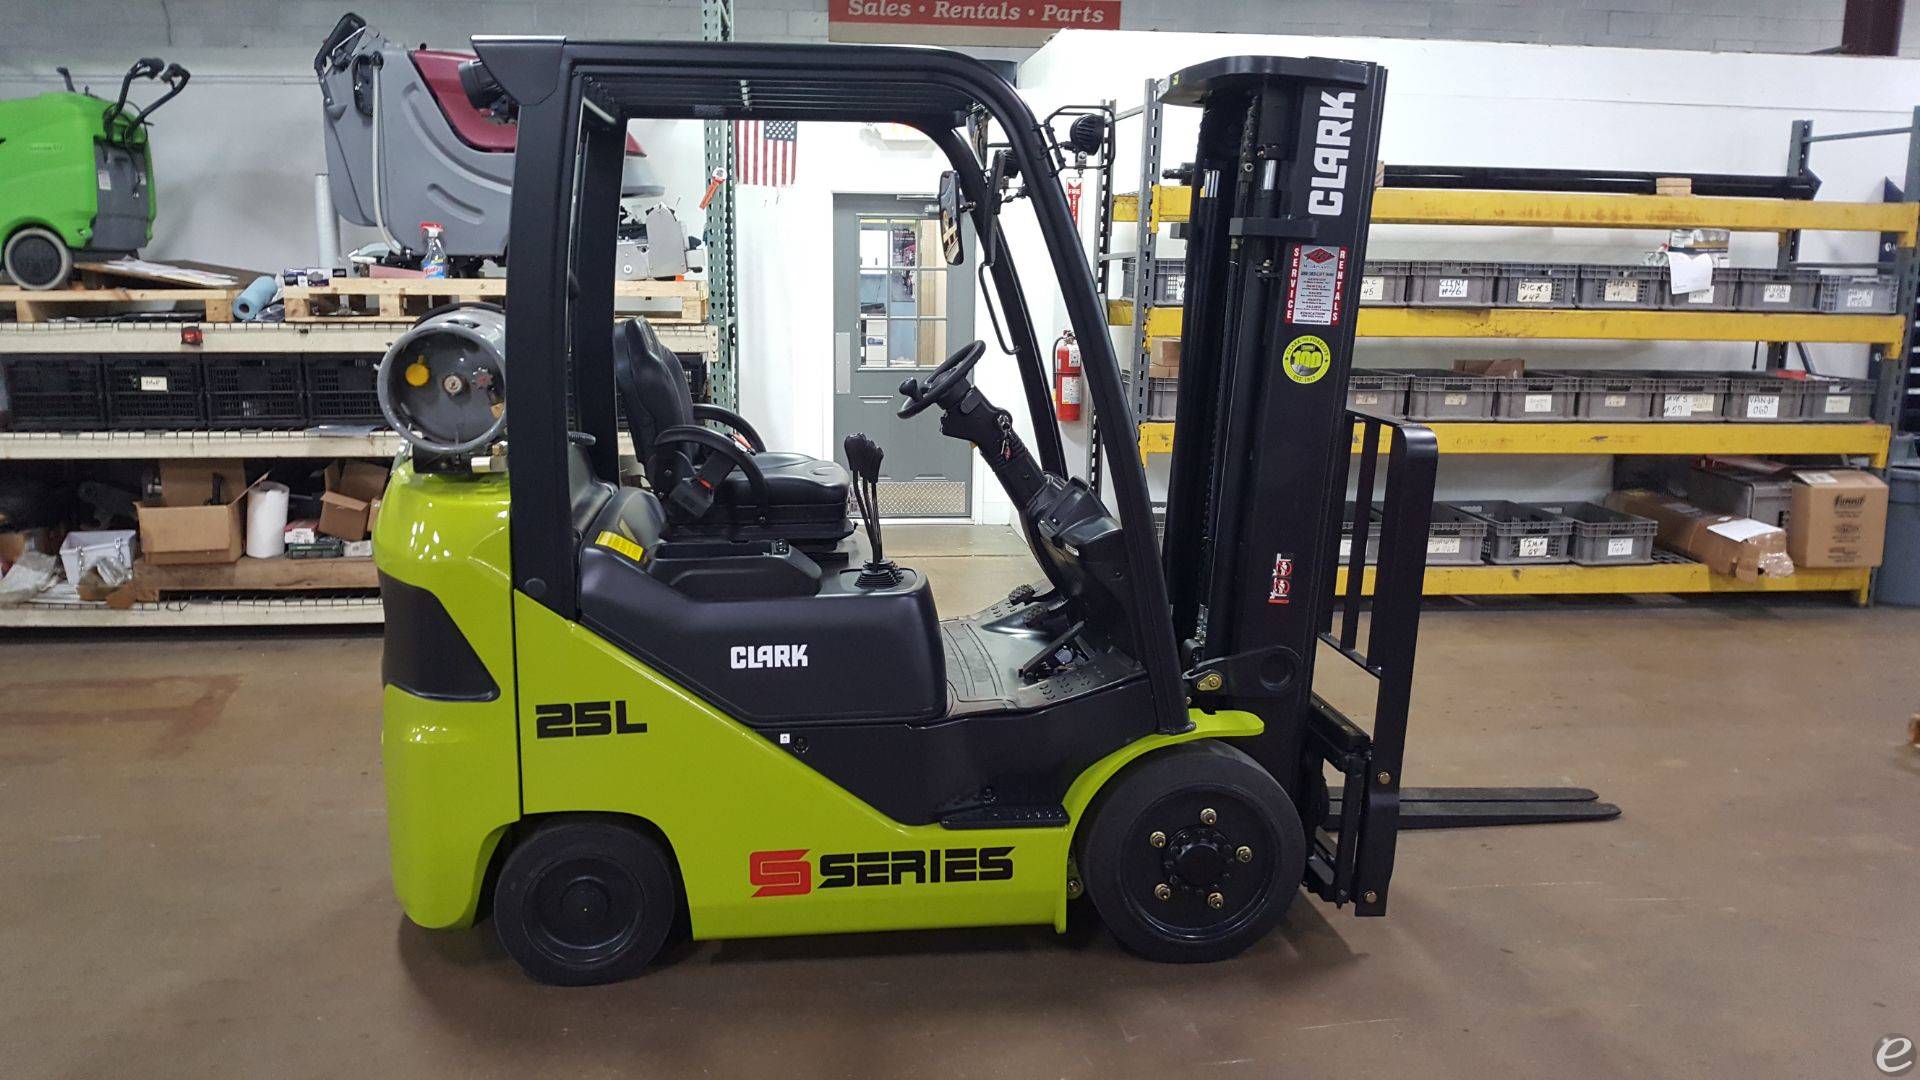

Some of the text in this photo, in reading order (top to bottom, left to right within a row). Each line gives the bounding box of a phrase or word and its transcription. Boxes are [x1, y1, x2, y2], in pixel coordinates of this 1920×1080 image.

[848, 0, 1105, 23] Sales Rentals Parts
[1307, 90, 1357, 217] CLARK
[1286, 247, 1300, 319] SERVICE
[1332, 250, 1346, 321] RENTALS
[730, 644, 809, 669] CLARK
[535, 700, 648, 739] 25L
[817, 846, 1017, 889] SERIES
